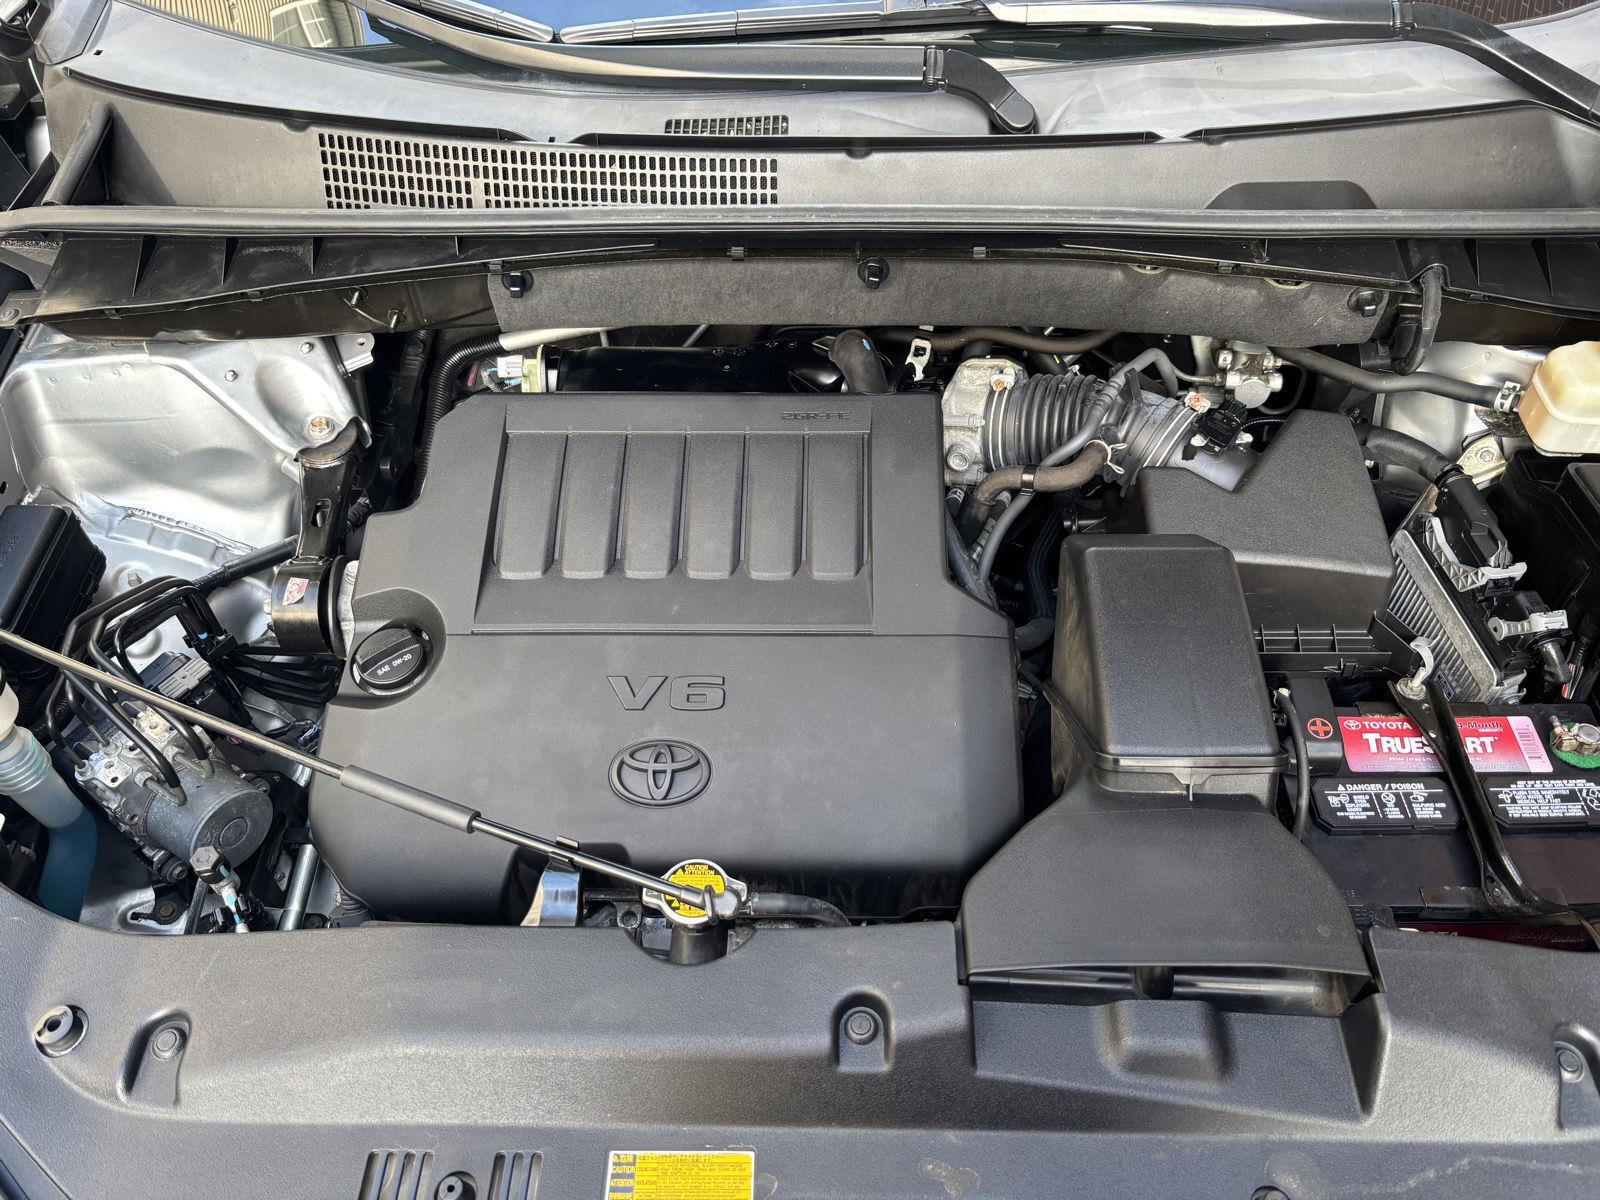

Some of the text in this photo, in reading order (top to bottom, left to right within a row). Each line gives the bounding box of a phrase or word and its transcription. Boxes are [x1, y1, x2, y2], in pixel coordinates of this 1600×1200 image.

[376, 654, 412, 676] SAE 0W-20
[606, 675, 726, 712] V6
[1362, 721, 1412, 730] TOYOTA
[1362, 732, 1495, 754] TRUESRT
